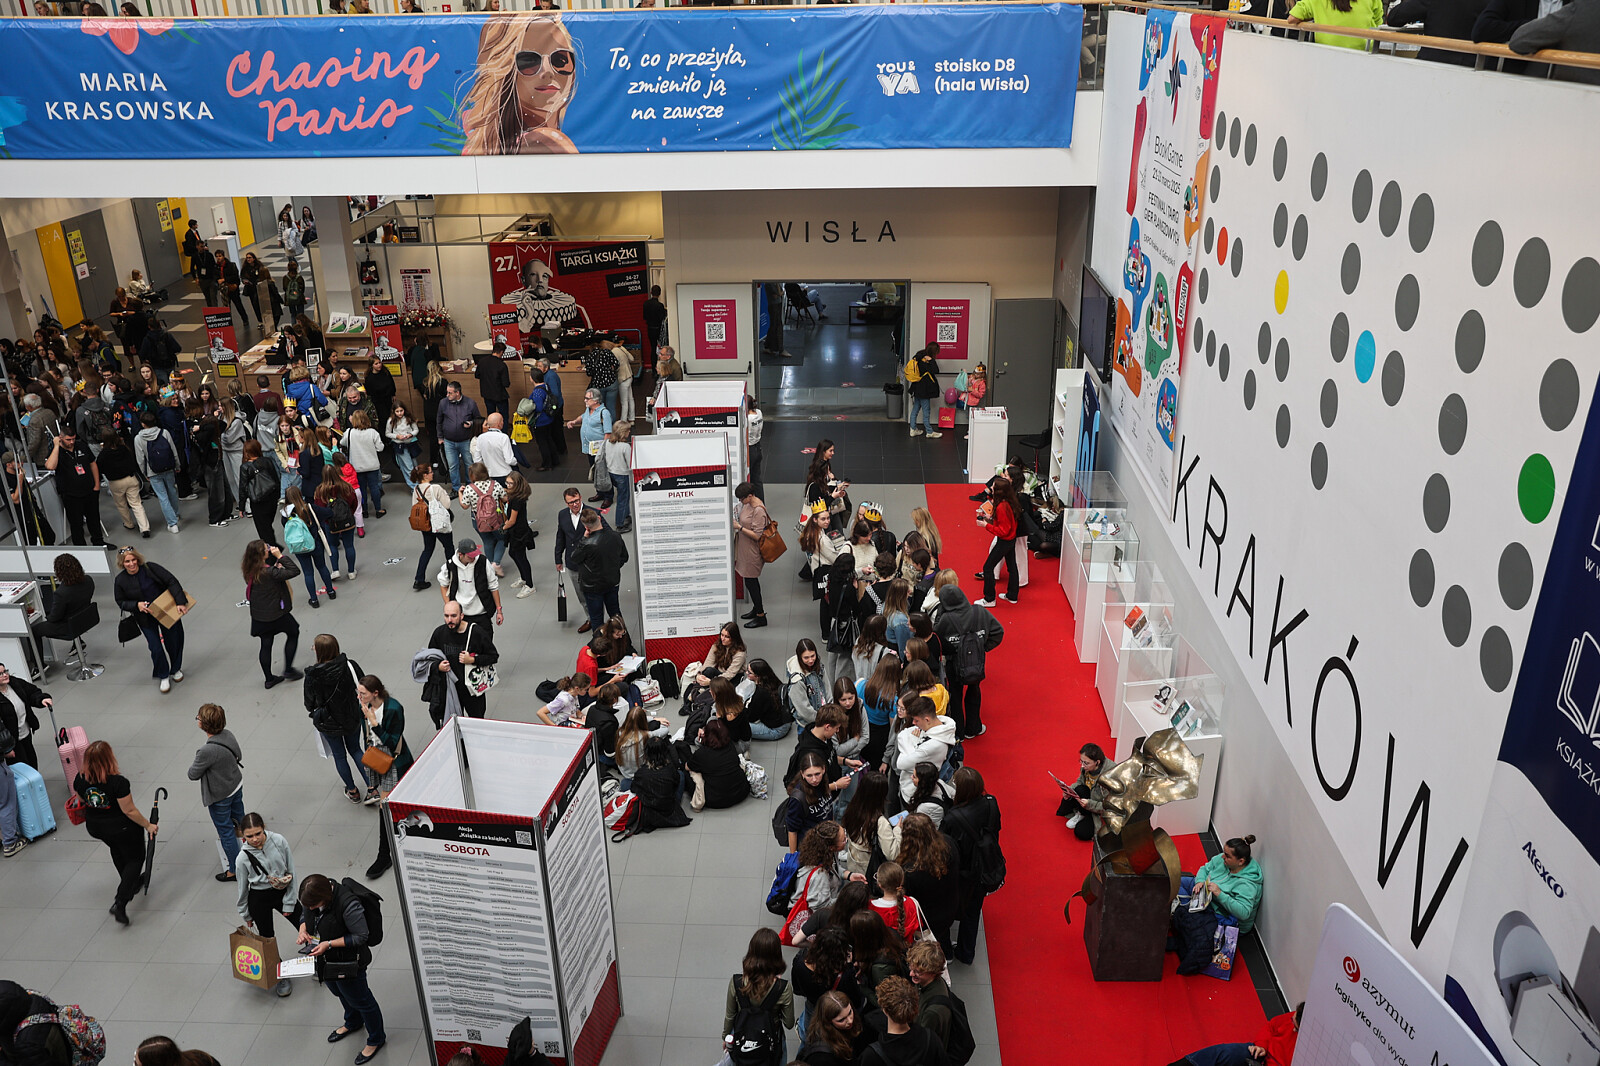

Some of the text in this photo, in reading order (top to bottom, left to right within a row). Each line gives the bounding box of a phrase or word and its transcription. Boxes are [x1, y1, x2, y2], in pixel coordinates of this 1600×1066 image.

[609, 43, 747, 72] To, co przeżyła,
[934, 58, 1016, 73] stoisko D8
[80, 72, 168, 92] MARIA
[225, 46, 440, 98] Chasing
[627, 71, 727, 99] zmieniło ją
[934, 74, 1030, 95] (hala Wisła)
[45, 101, 215, 121] KRASOWSKA
[259, 97, 414, 142] Paris
[630, 105, 725, 120] na zawsze
[53, 229, 61, 242] A
[766, 220, 897, 243] WISŁA
[494, 255, 518, 272] 27.
[560, 247, 638, 268] TARGI KSIĄŻKI
[372, 314, 398, 322] RECEPCJA
[491, 313, 517, 321] RECEPCJA
[668, 490, 694, 499] PIĄTEK
[1172, 434, 1470, 950] KRAKÓW
[561, 796, 580, 828] SOBOTA
[443, 843, 491, 857] SOBOTA
[1521, 841, 1565, 899] Atexco
[1334, 982, 1372, 1028] logistyka
[1372, 1026, 1387, 1045] dla
[1361, 977, 1416, 1040] azymut
